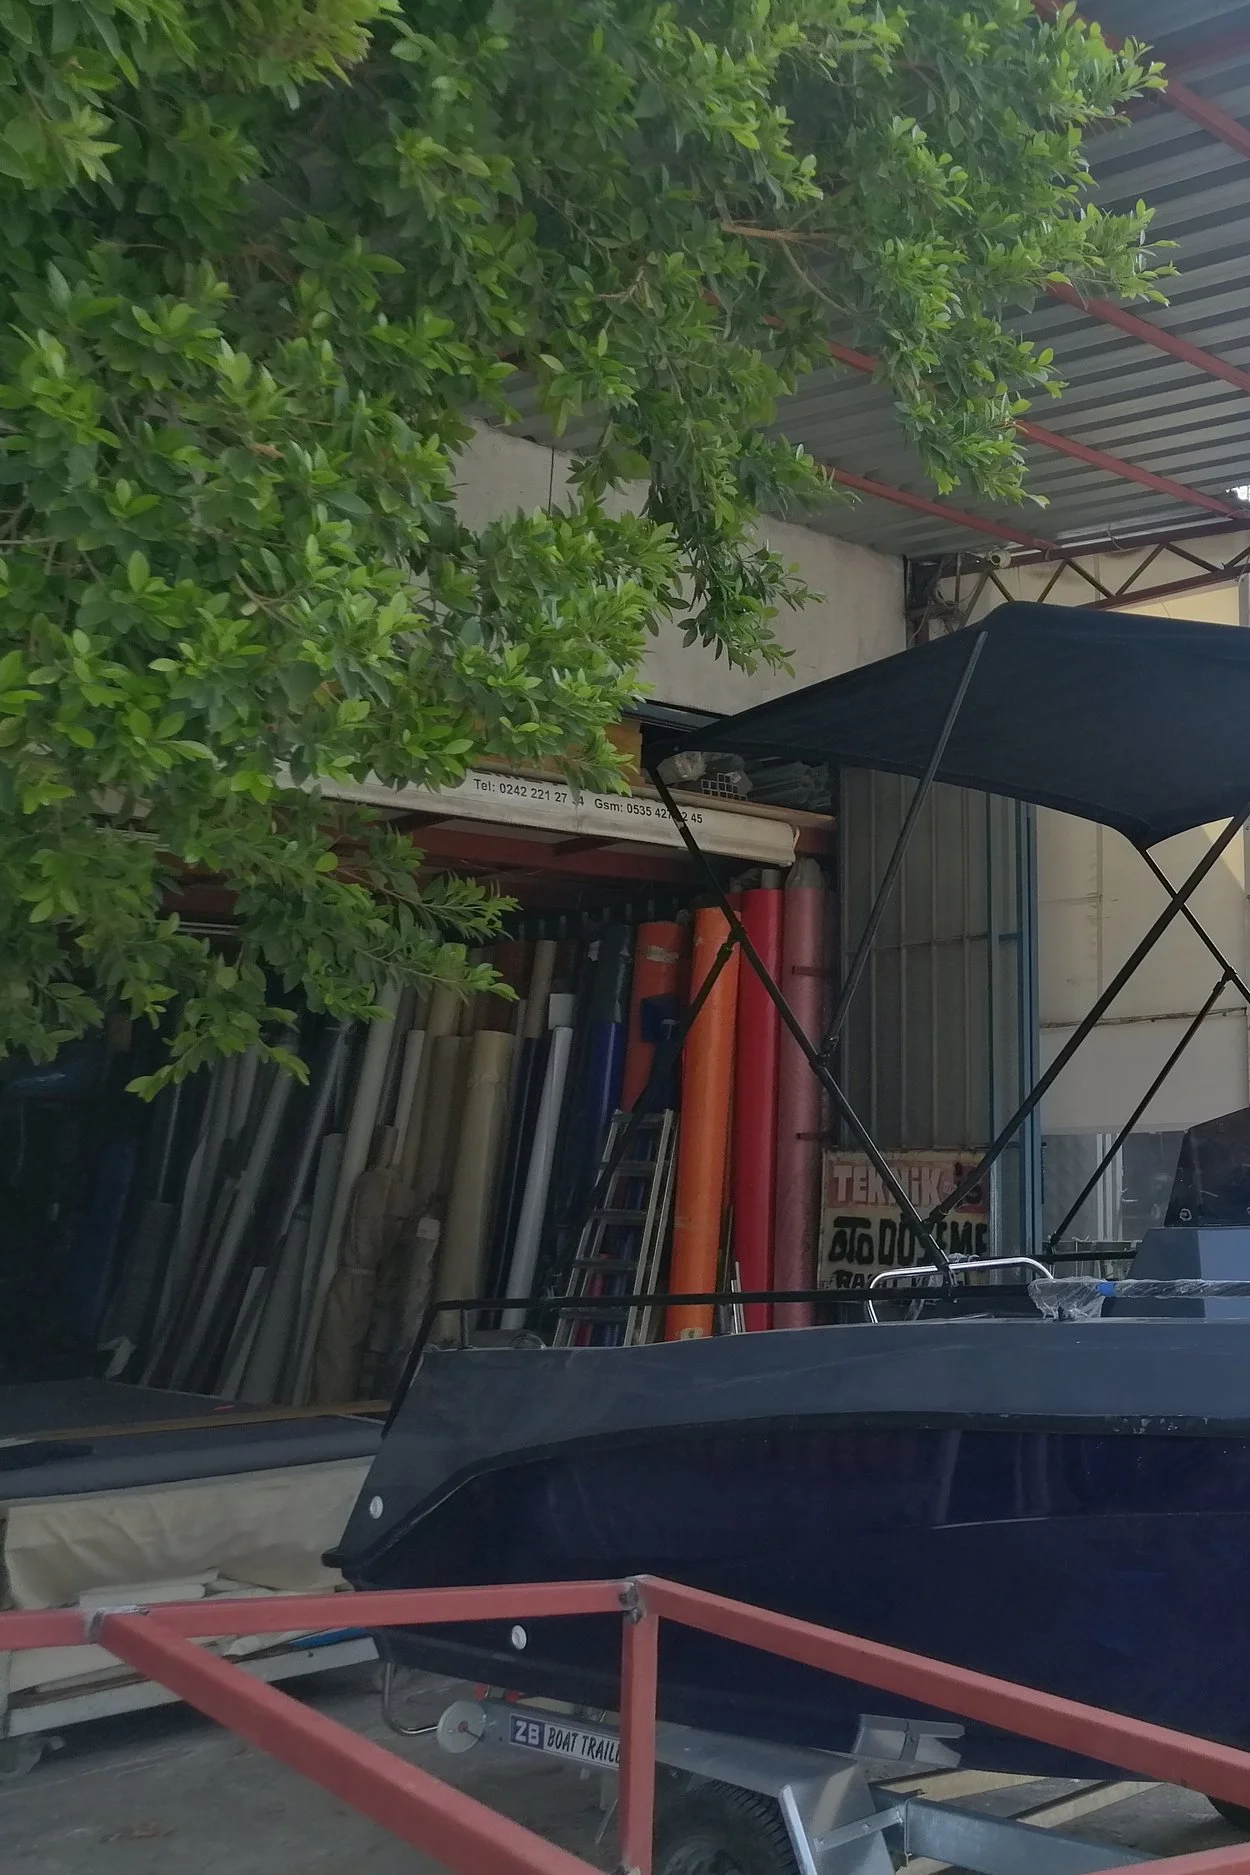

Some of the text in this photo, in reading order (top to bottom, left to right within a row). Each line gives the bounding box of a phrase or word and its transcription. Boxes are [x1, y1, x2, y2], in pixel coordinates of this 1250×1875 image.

[473, 778, 495, 792] Tel:
[499, 783, 527, 797] 0242
[530, 787, 550, 801] 221
[554, 791, 567, 803] 27
[594, 798, 623, 812] Gsm:
[626, 803, 652, 817] 0535
[691, 813, 703, 824] 45
[513, 1719, 541, 1746] ZB
[547, 1726, 580, 1753] BOAT
